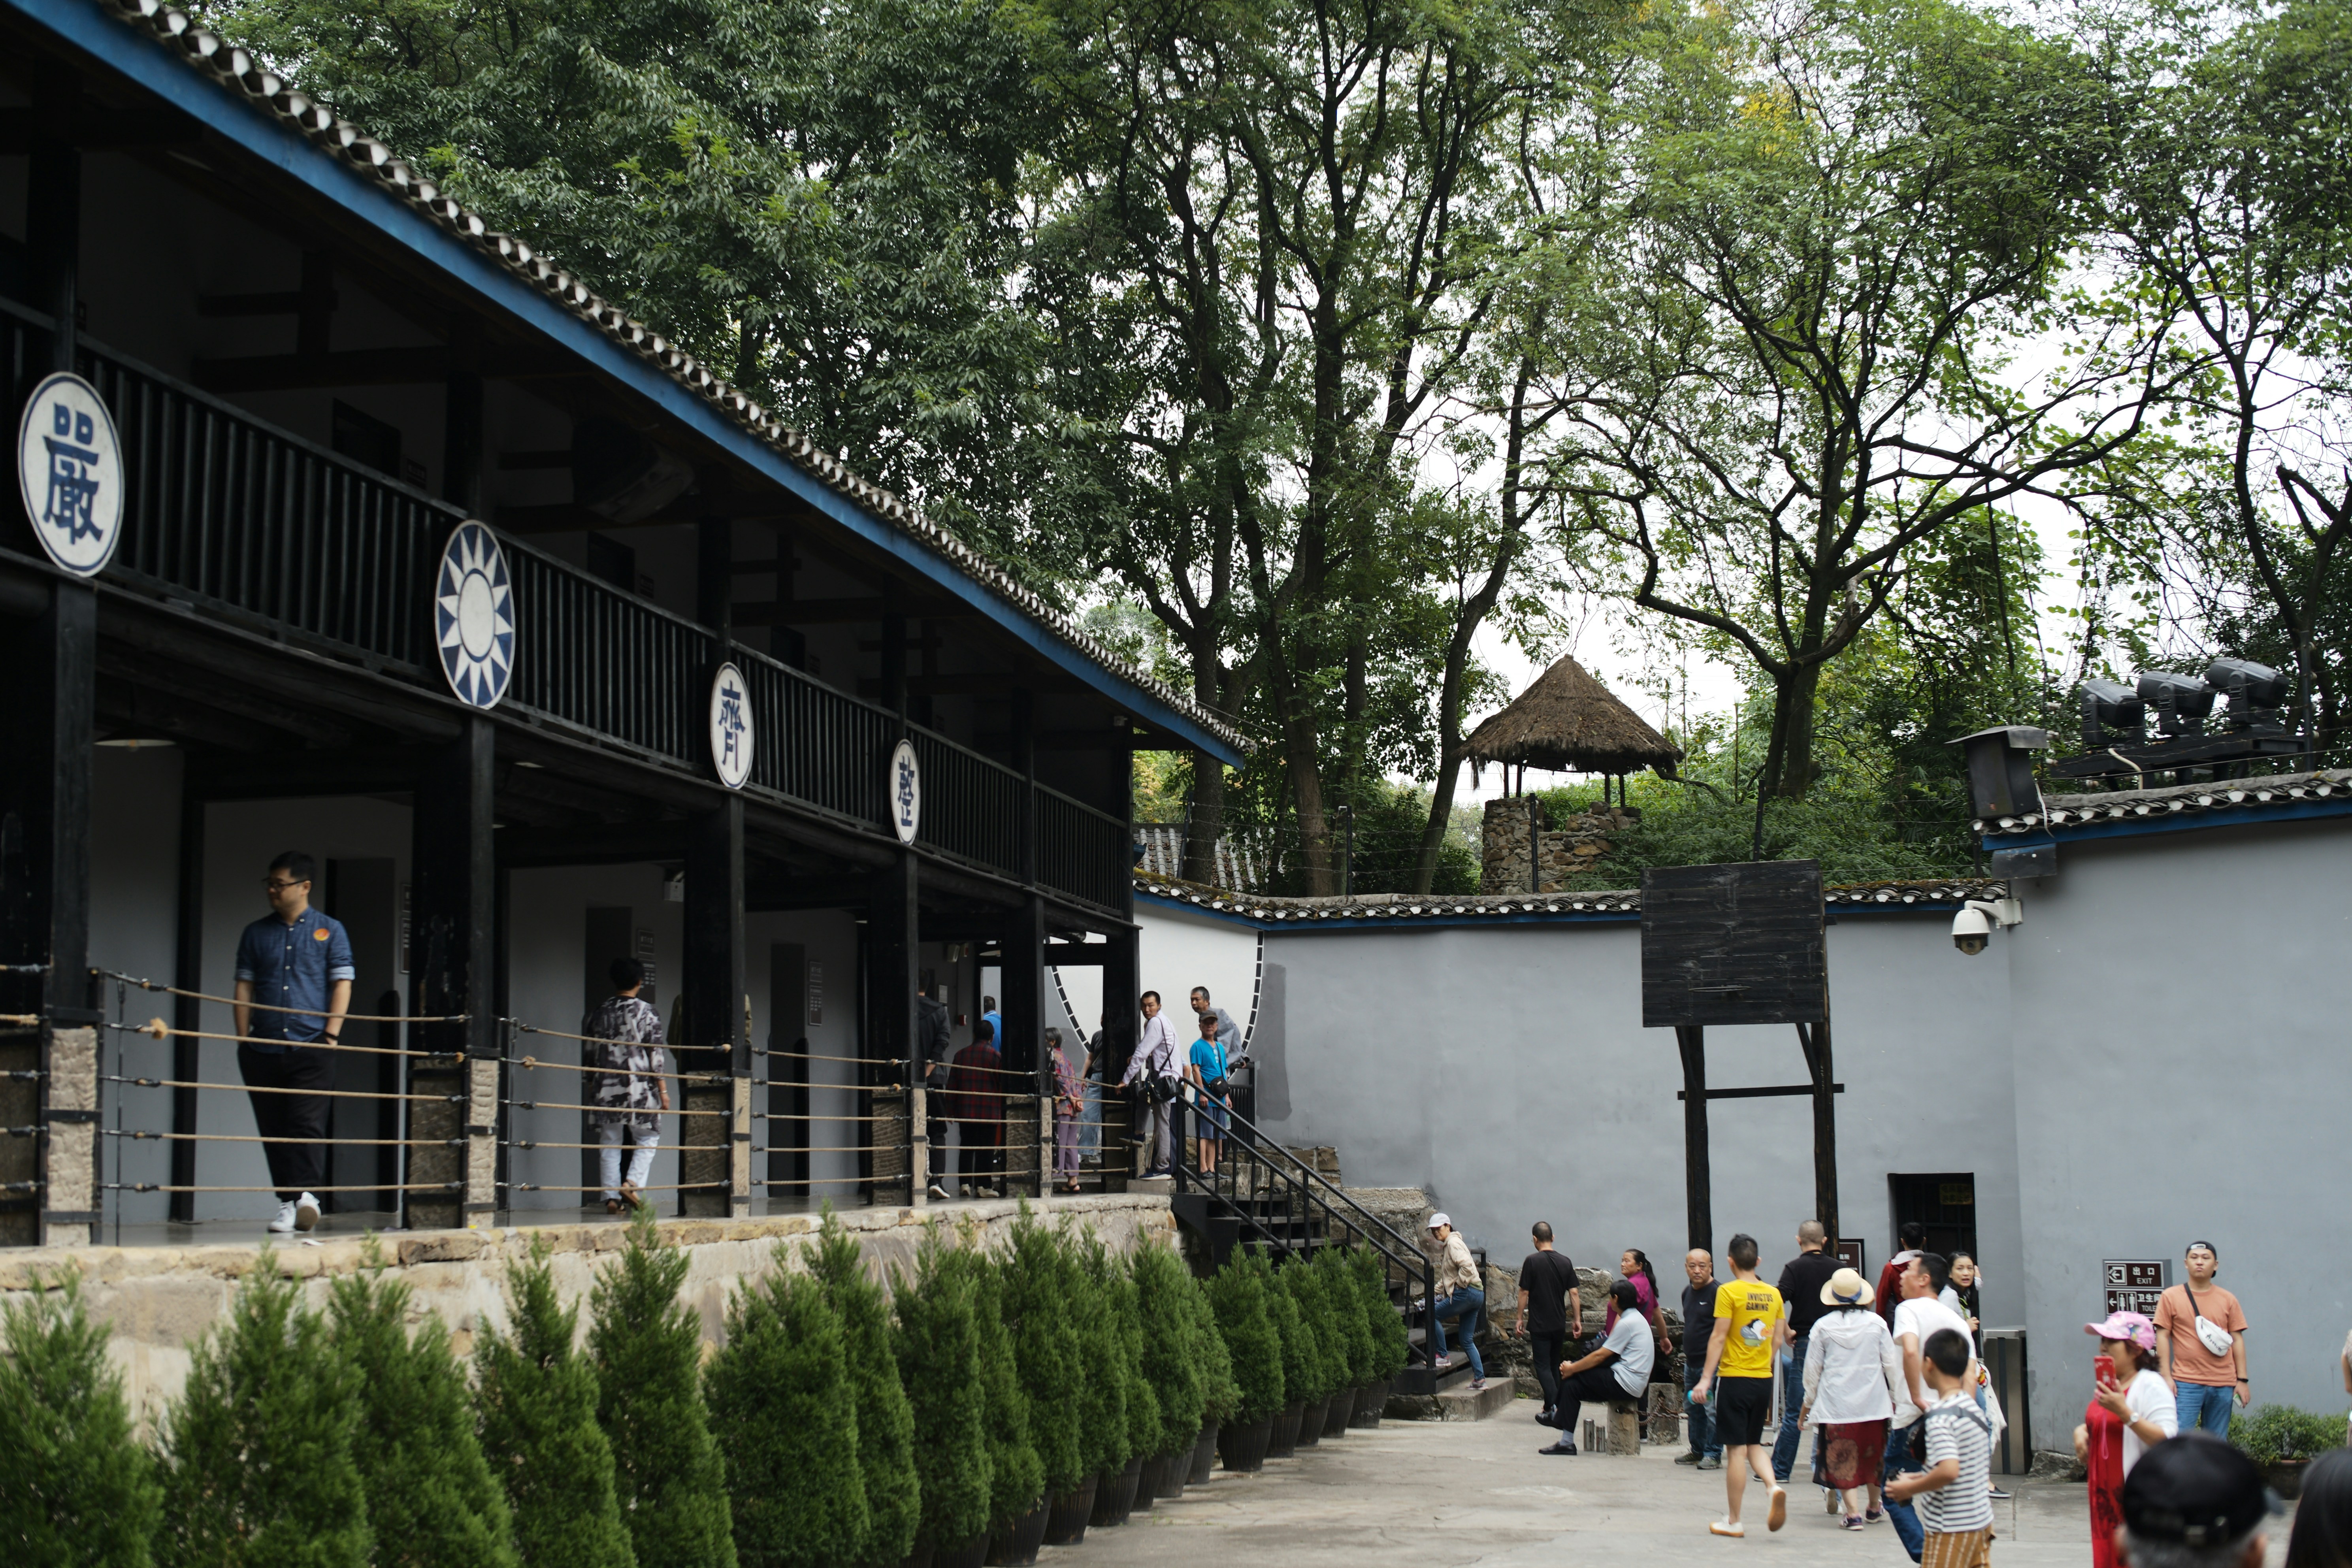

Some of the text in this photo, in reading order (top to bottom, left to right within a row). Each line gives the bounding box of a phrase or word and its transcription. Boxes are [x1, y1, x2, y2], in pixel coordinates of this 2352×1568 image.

[42, 401, 104, 545] 嚴
[718, 680, 746, 773] 齊
[898, 755, 915, 827] 整
[2132, 1266, 2155, 1276] 出口
[1748, 1293, 1773, 1302] INVICTUS
[2137, 1293, 2161, 1302] 卫生间
[1746, 1302, 1768, 1311] GAMING
